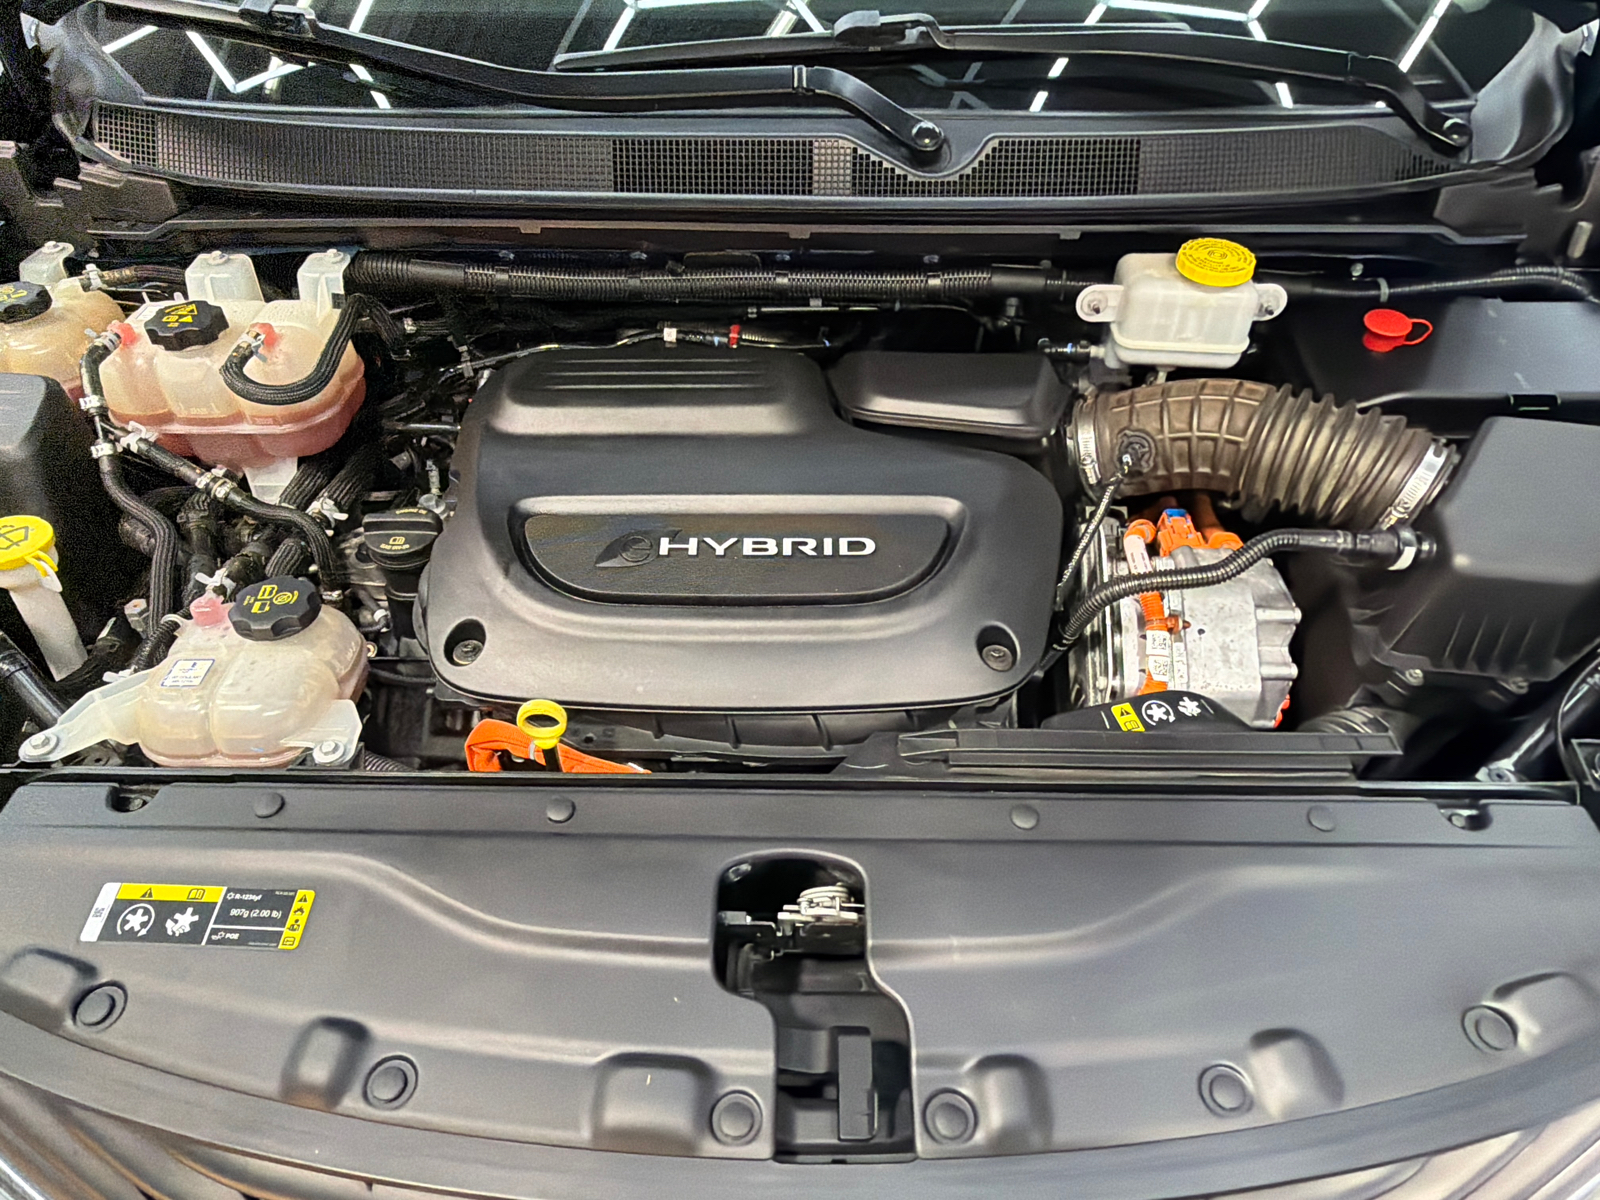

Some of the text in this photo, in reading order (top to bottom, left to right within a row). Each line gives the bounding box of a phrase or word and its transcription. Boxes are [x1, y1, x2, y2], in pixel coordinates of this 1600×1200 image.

[658, 536, 876, 556] HYBRID
[230, 908, 282, 919] 907g (2.00 lb)
